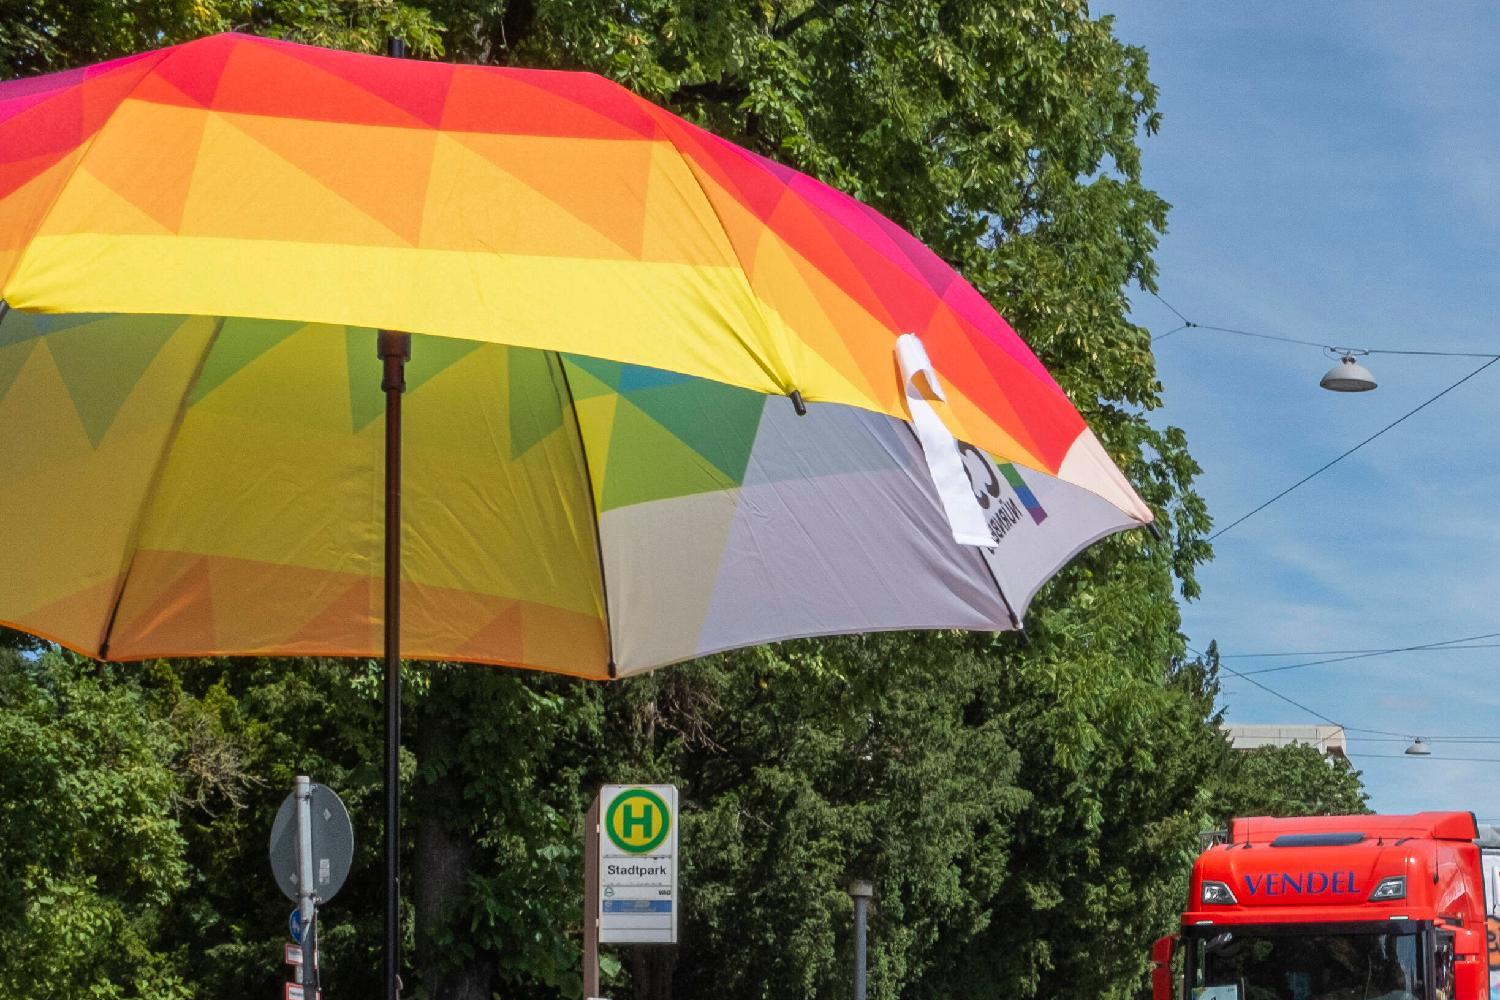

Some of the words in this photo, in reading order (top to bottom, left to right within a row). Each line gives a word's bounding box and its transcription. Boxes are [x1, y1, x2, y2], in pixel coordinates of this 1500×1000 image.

[623, 804, 652, 838] H
[607, 865, 667, 877] Stadtpark
[1244, 871, 1361, 896] VENDEL
